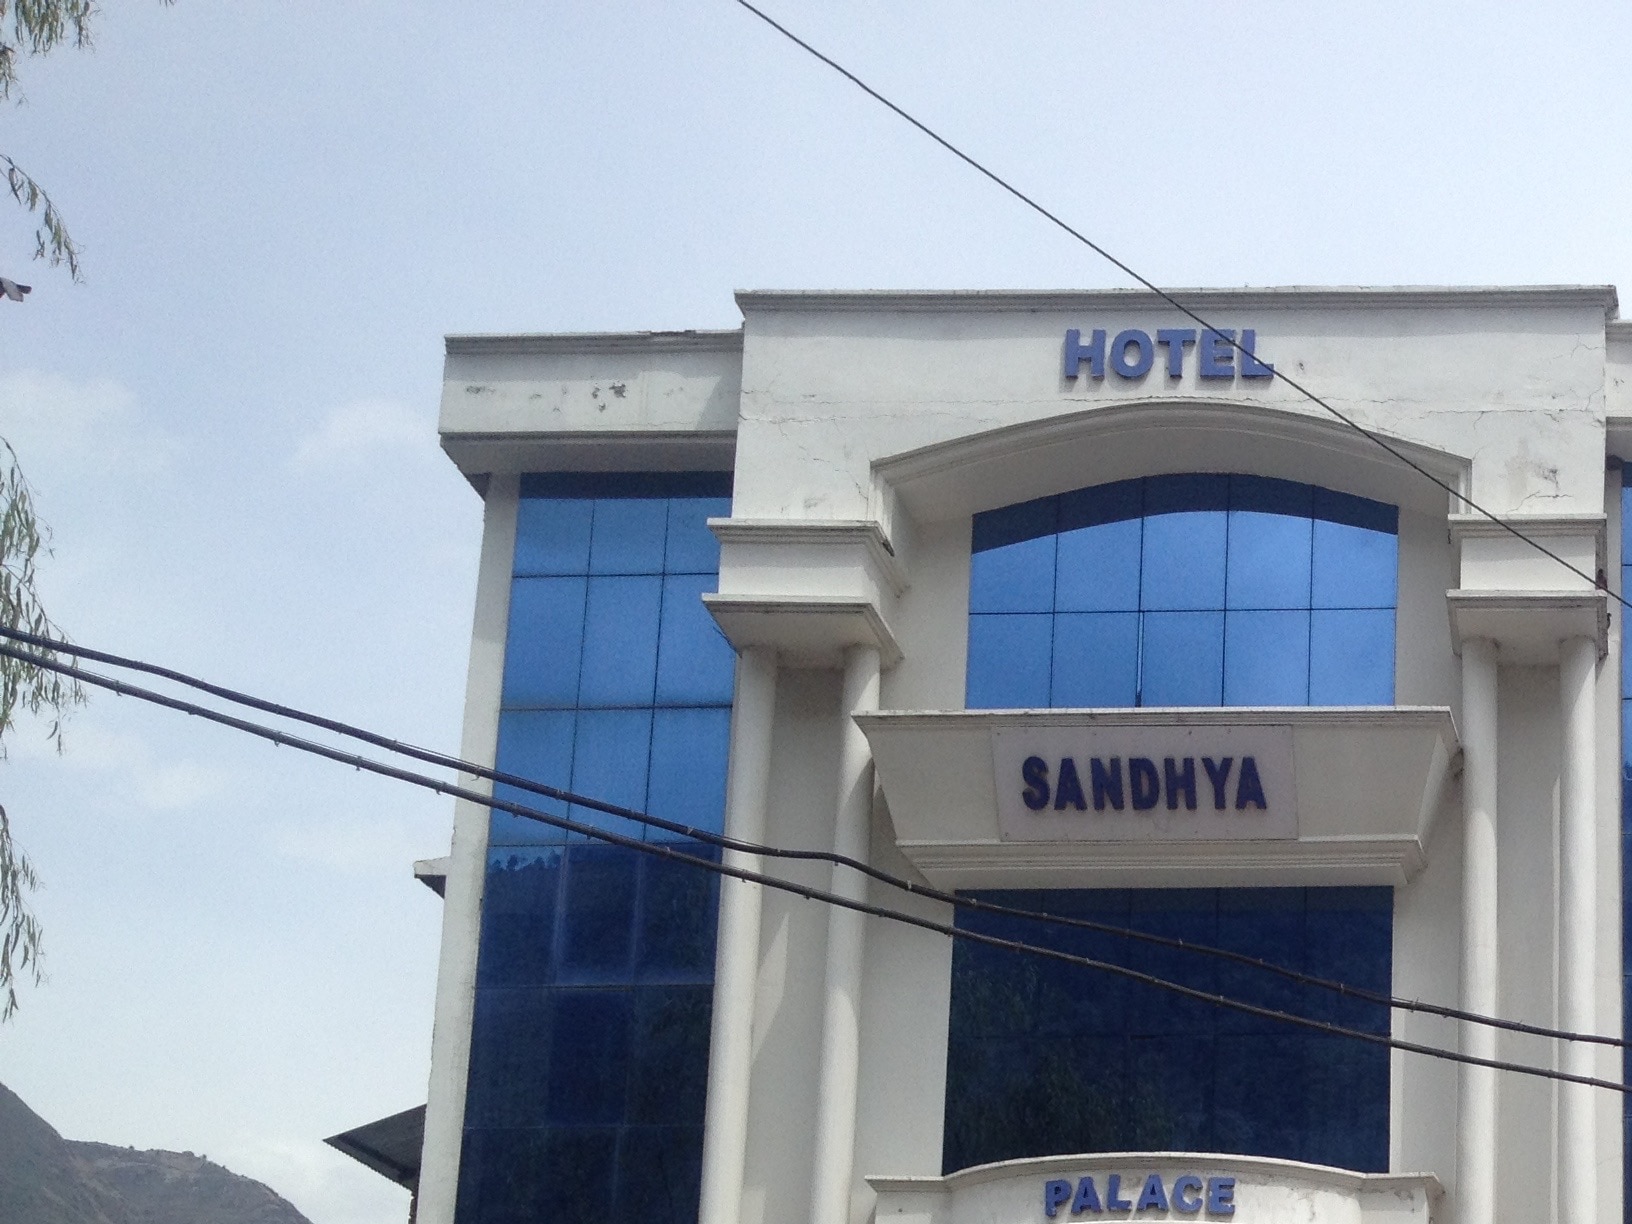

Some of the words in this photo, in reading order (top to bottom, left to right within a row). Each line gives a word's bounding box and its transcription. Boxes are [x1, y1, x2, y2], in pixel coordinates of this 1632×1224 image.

[1064, 328, 1274, 379] HOTEL
[1022, 756, 1267, 811] SANDHYA
[1045, 1174, 1236, 1217] PALACE
